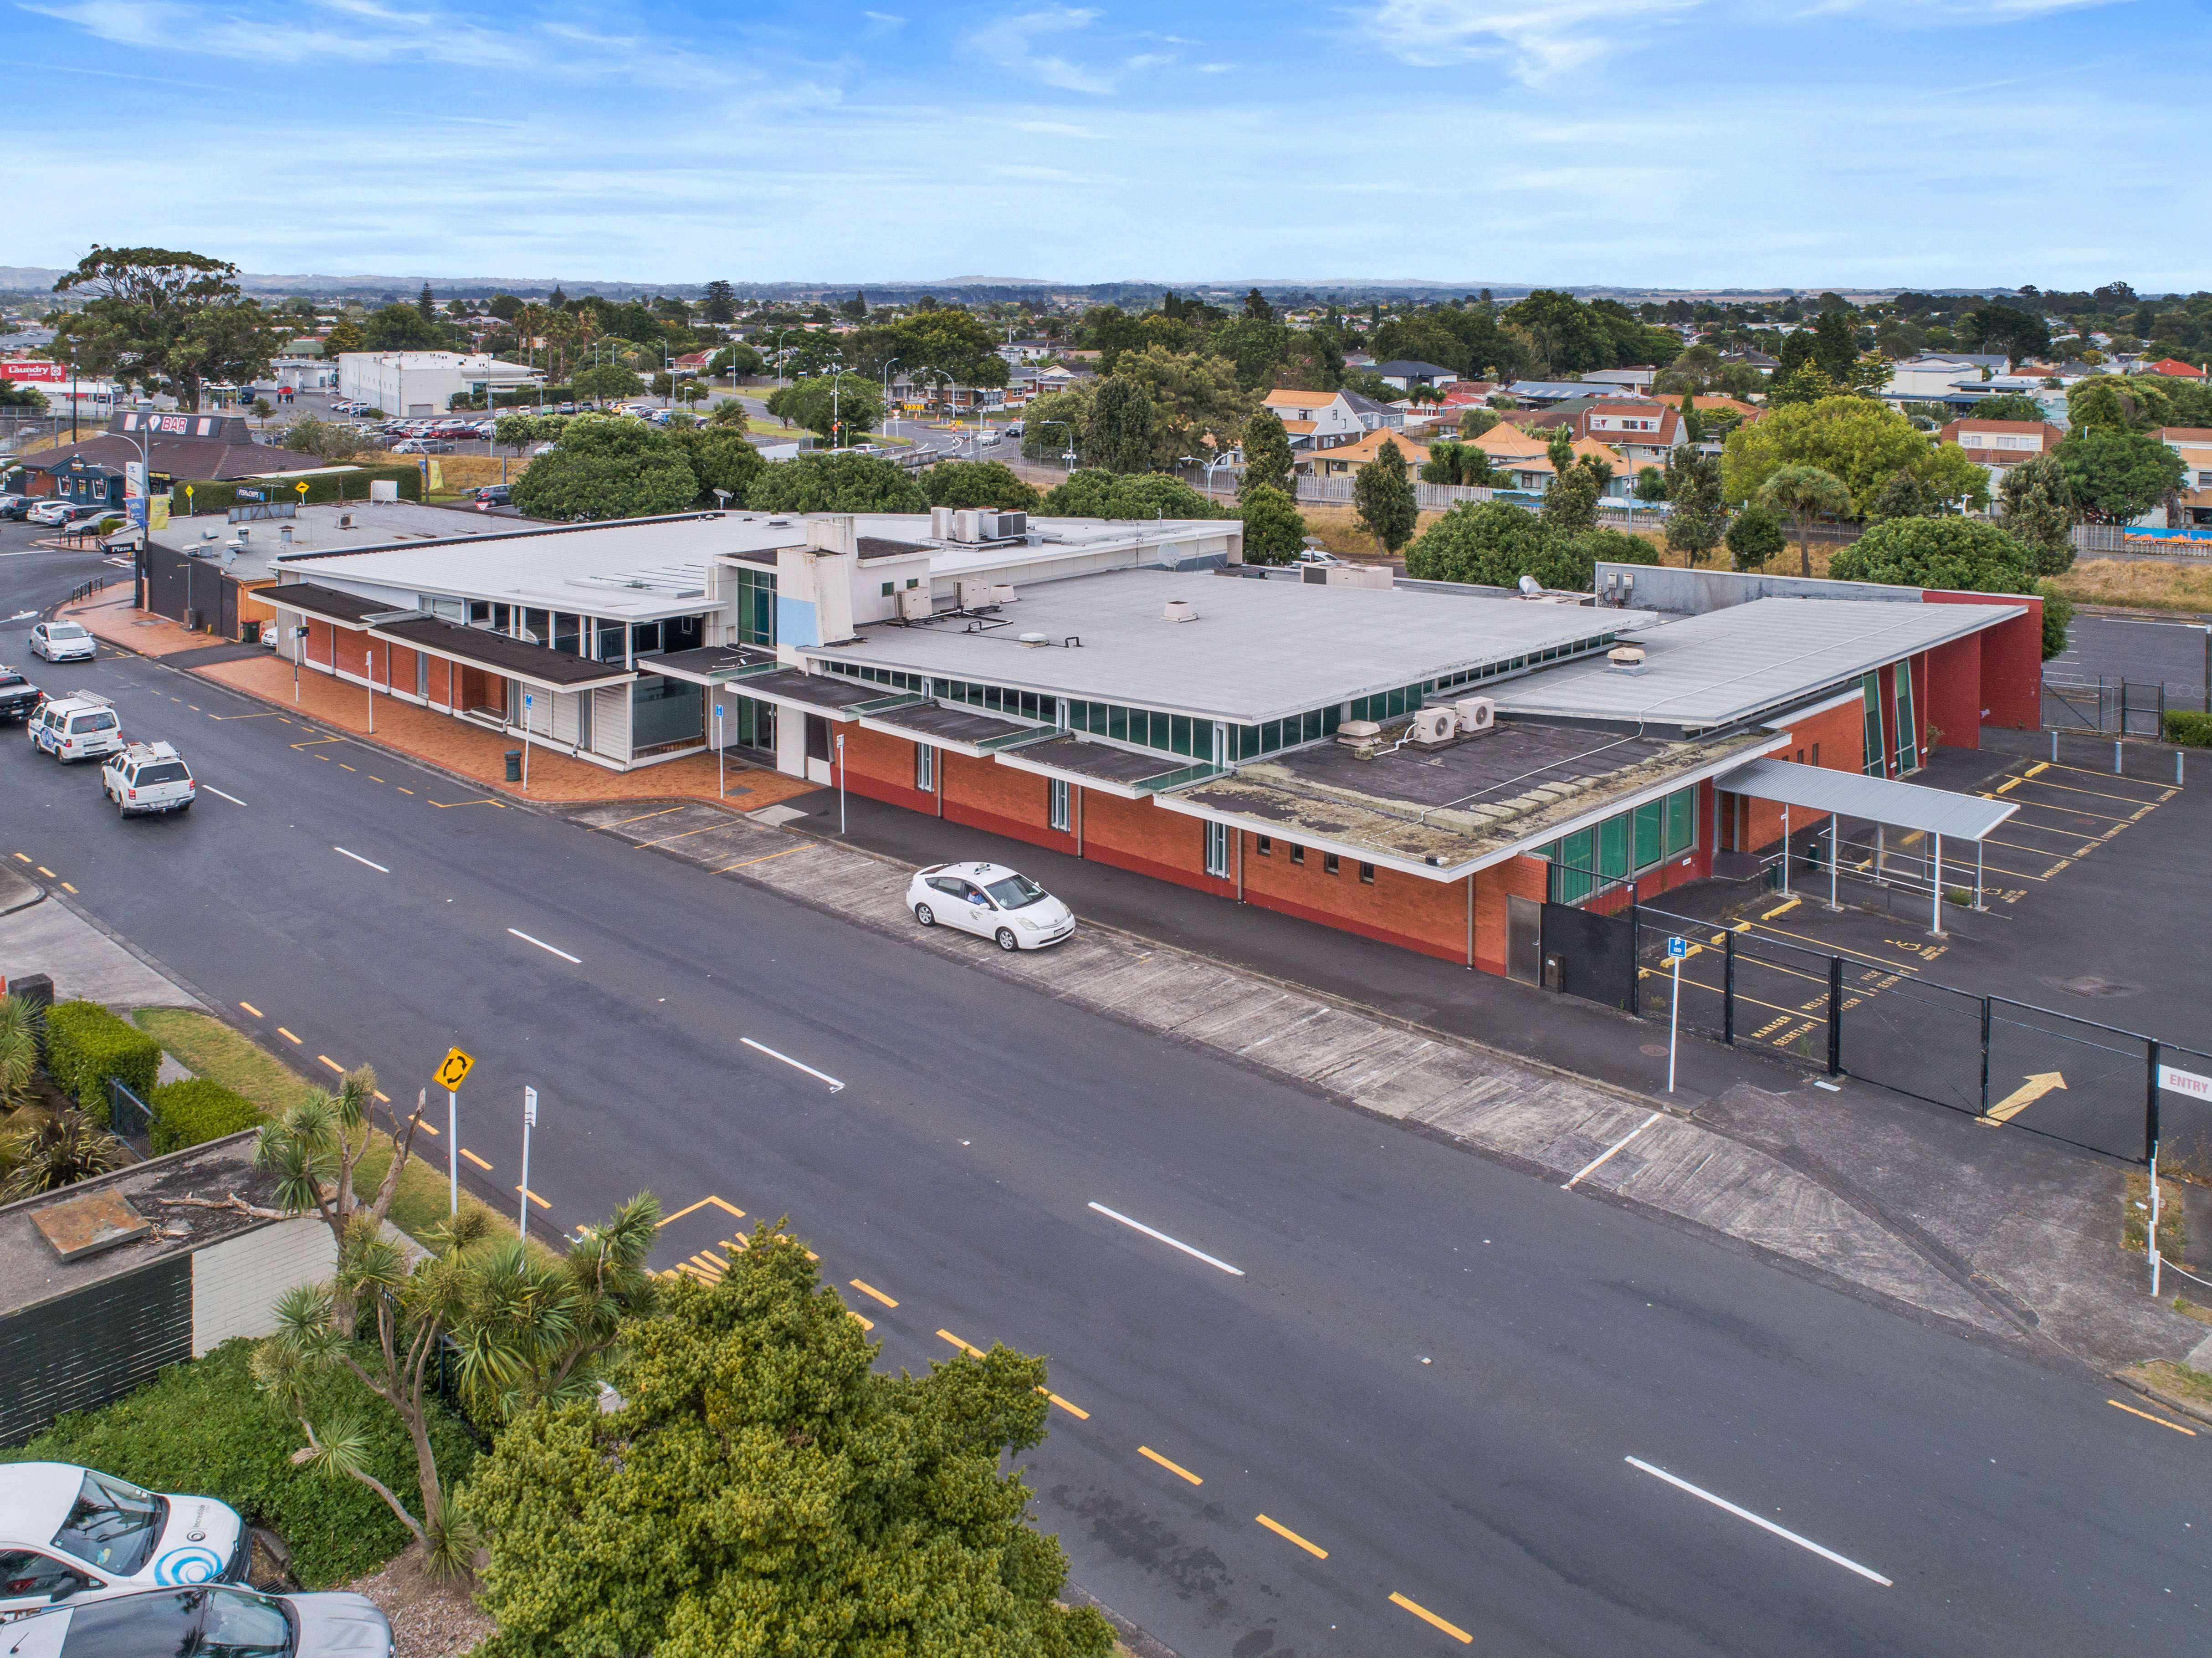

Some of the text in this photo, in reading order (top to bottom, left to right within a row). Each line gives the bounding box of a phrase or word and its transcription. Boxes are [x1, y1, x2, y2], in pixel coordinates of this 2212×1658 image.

[9, 366, 49, 374] Laundry
[161, 416, 187, 432] BAR
[2040, 860, 2072, 878] PRESIDENT
[1859, 970, 1883, 981] VICE
[1751, 1016, 1792, 1039] MANAGER
[1772, 1021, 1818, 1046] SECRETARY
[2170, 1074, 2208, 1094] ENTRY
